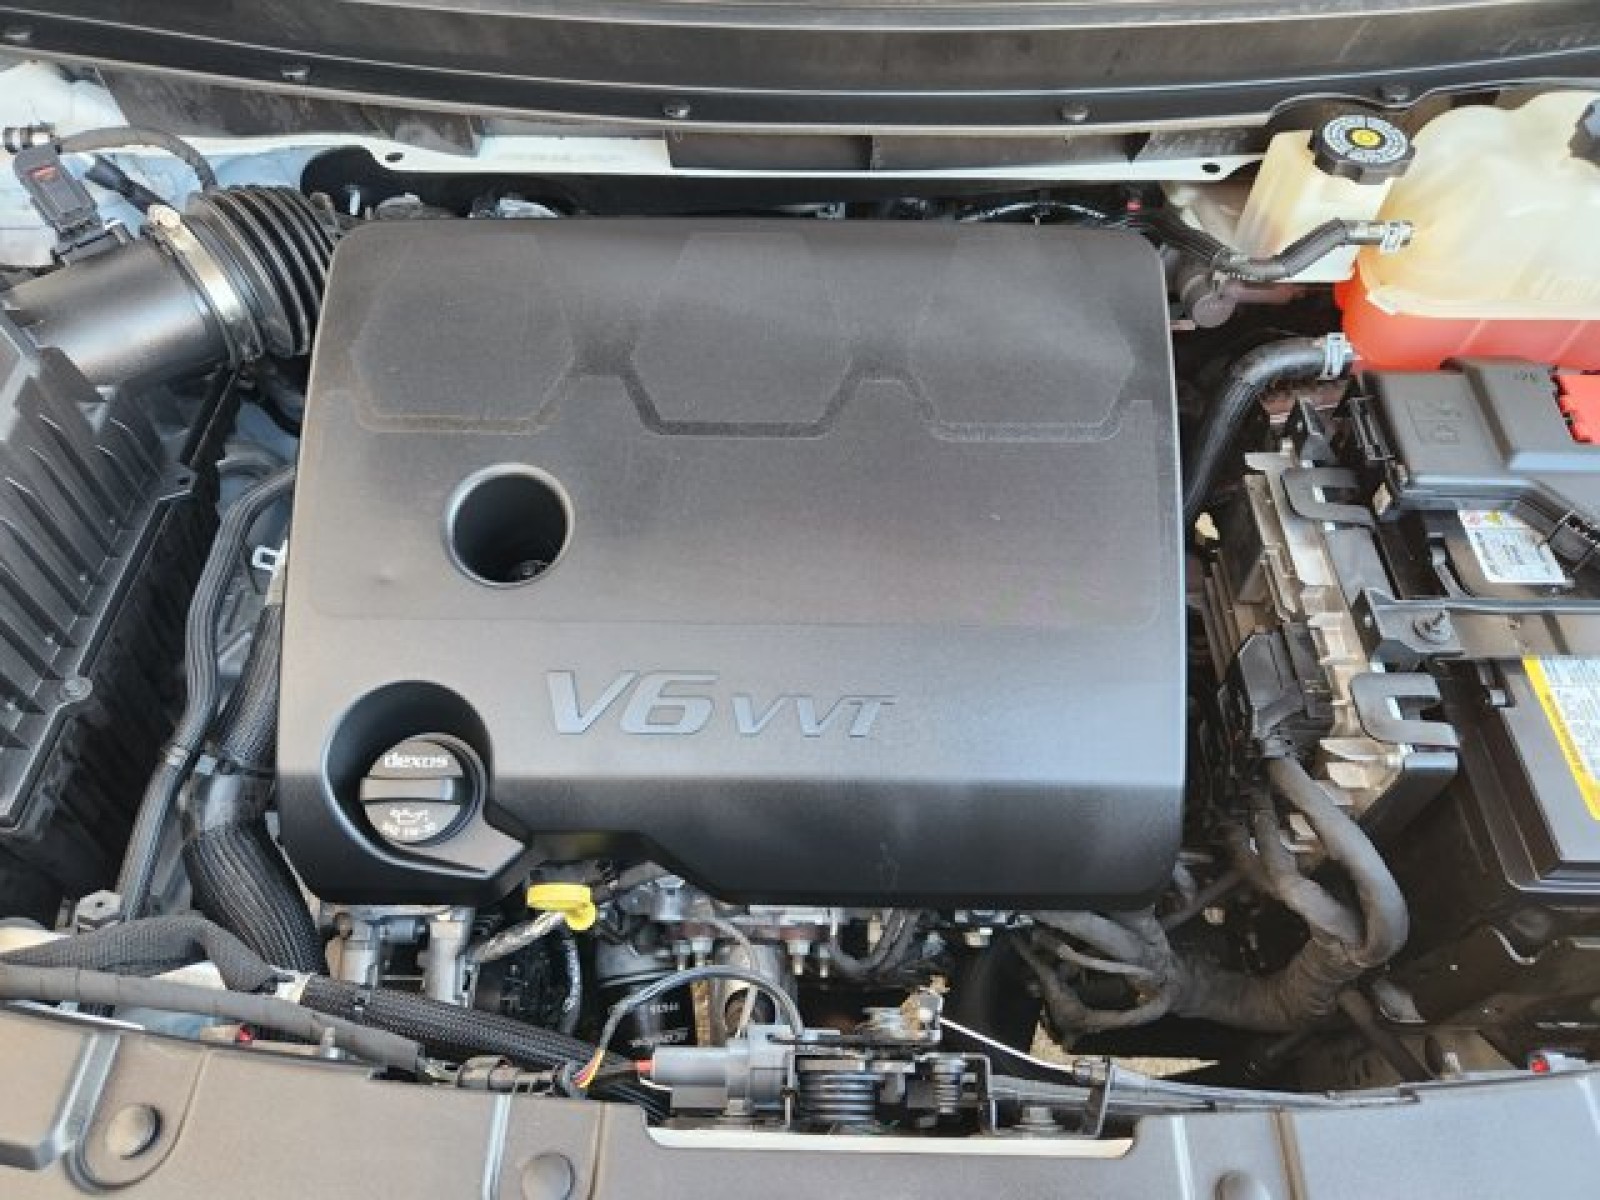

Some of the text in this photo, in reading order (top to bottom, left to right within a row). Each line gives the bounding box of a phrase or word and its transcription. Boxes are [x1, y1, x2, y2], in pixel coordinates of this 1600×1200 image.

[547, 670, 895, 738] V6 VVT
[384, 752, 449, 769] dexos
